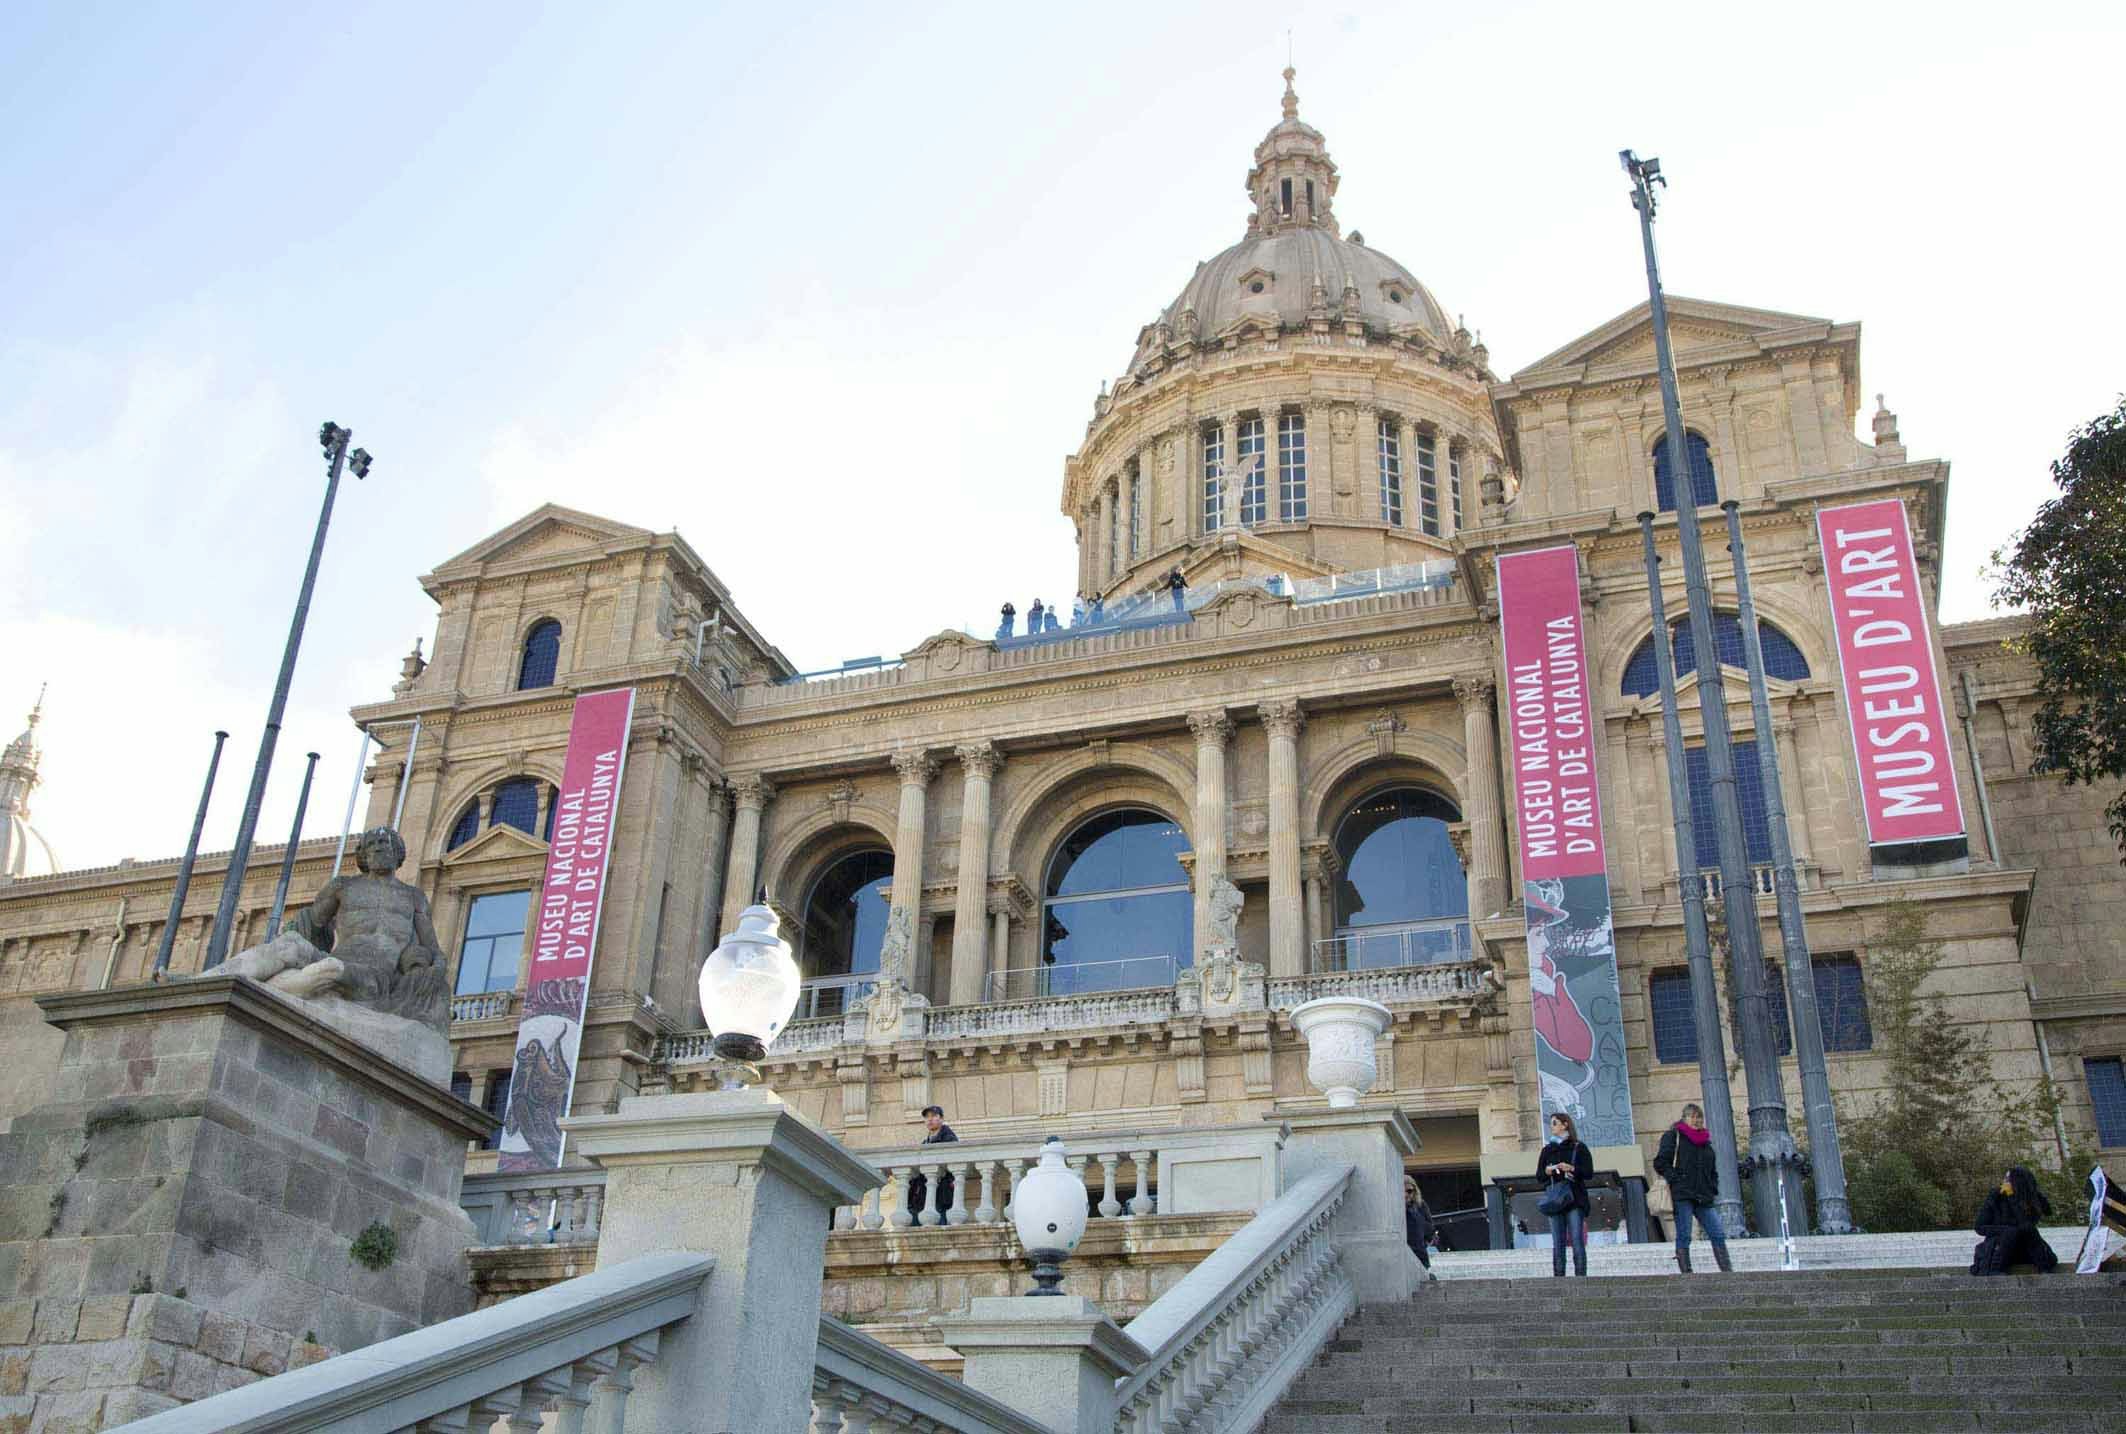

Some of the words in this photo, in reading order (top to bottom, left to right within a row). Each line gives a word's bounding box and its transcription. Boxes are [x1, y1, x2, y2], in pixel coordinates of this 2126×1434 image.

[1834, 527, 1913, 649] D'ART
[1513, 659, 1550, 772] NACIONAL
[1546, 615, 1585, 739] CATALUNYA
[1557, 746, 1589, 777] DE
[1858, 664, 1944, 818] MUSEU
[549, 787, 586, 887] NACIONAL
[580, 749, 617, 859] CATALUNYA
[1521, 779, 1558, 858] MUSEU
[1560, 786, 1596, 855] D'ART
[574, 865, 599, 892] DE
[536, 893, 569, 962] MUSEU
[563, 900, 594, 960] D'ART
